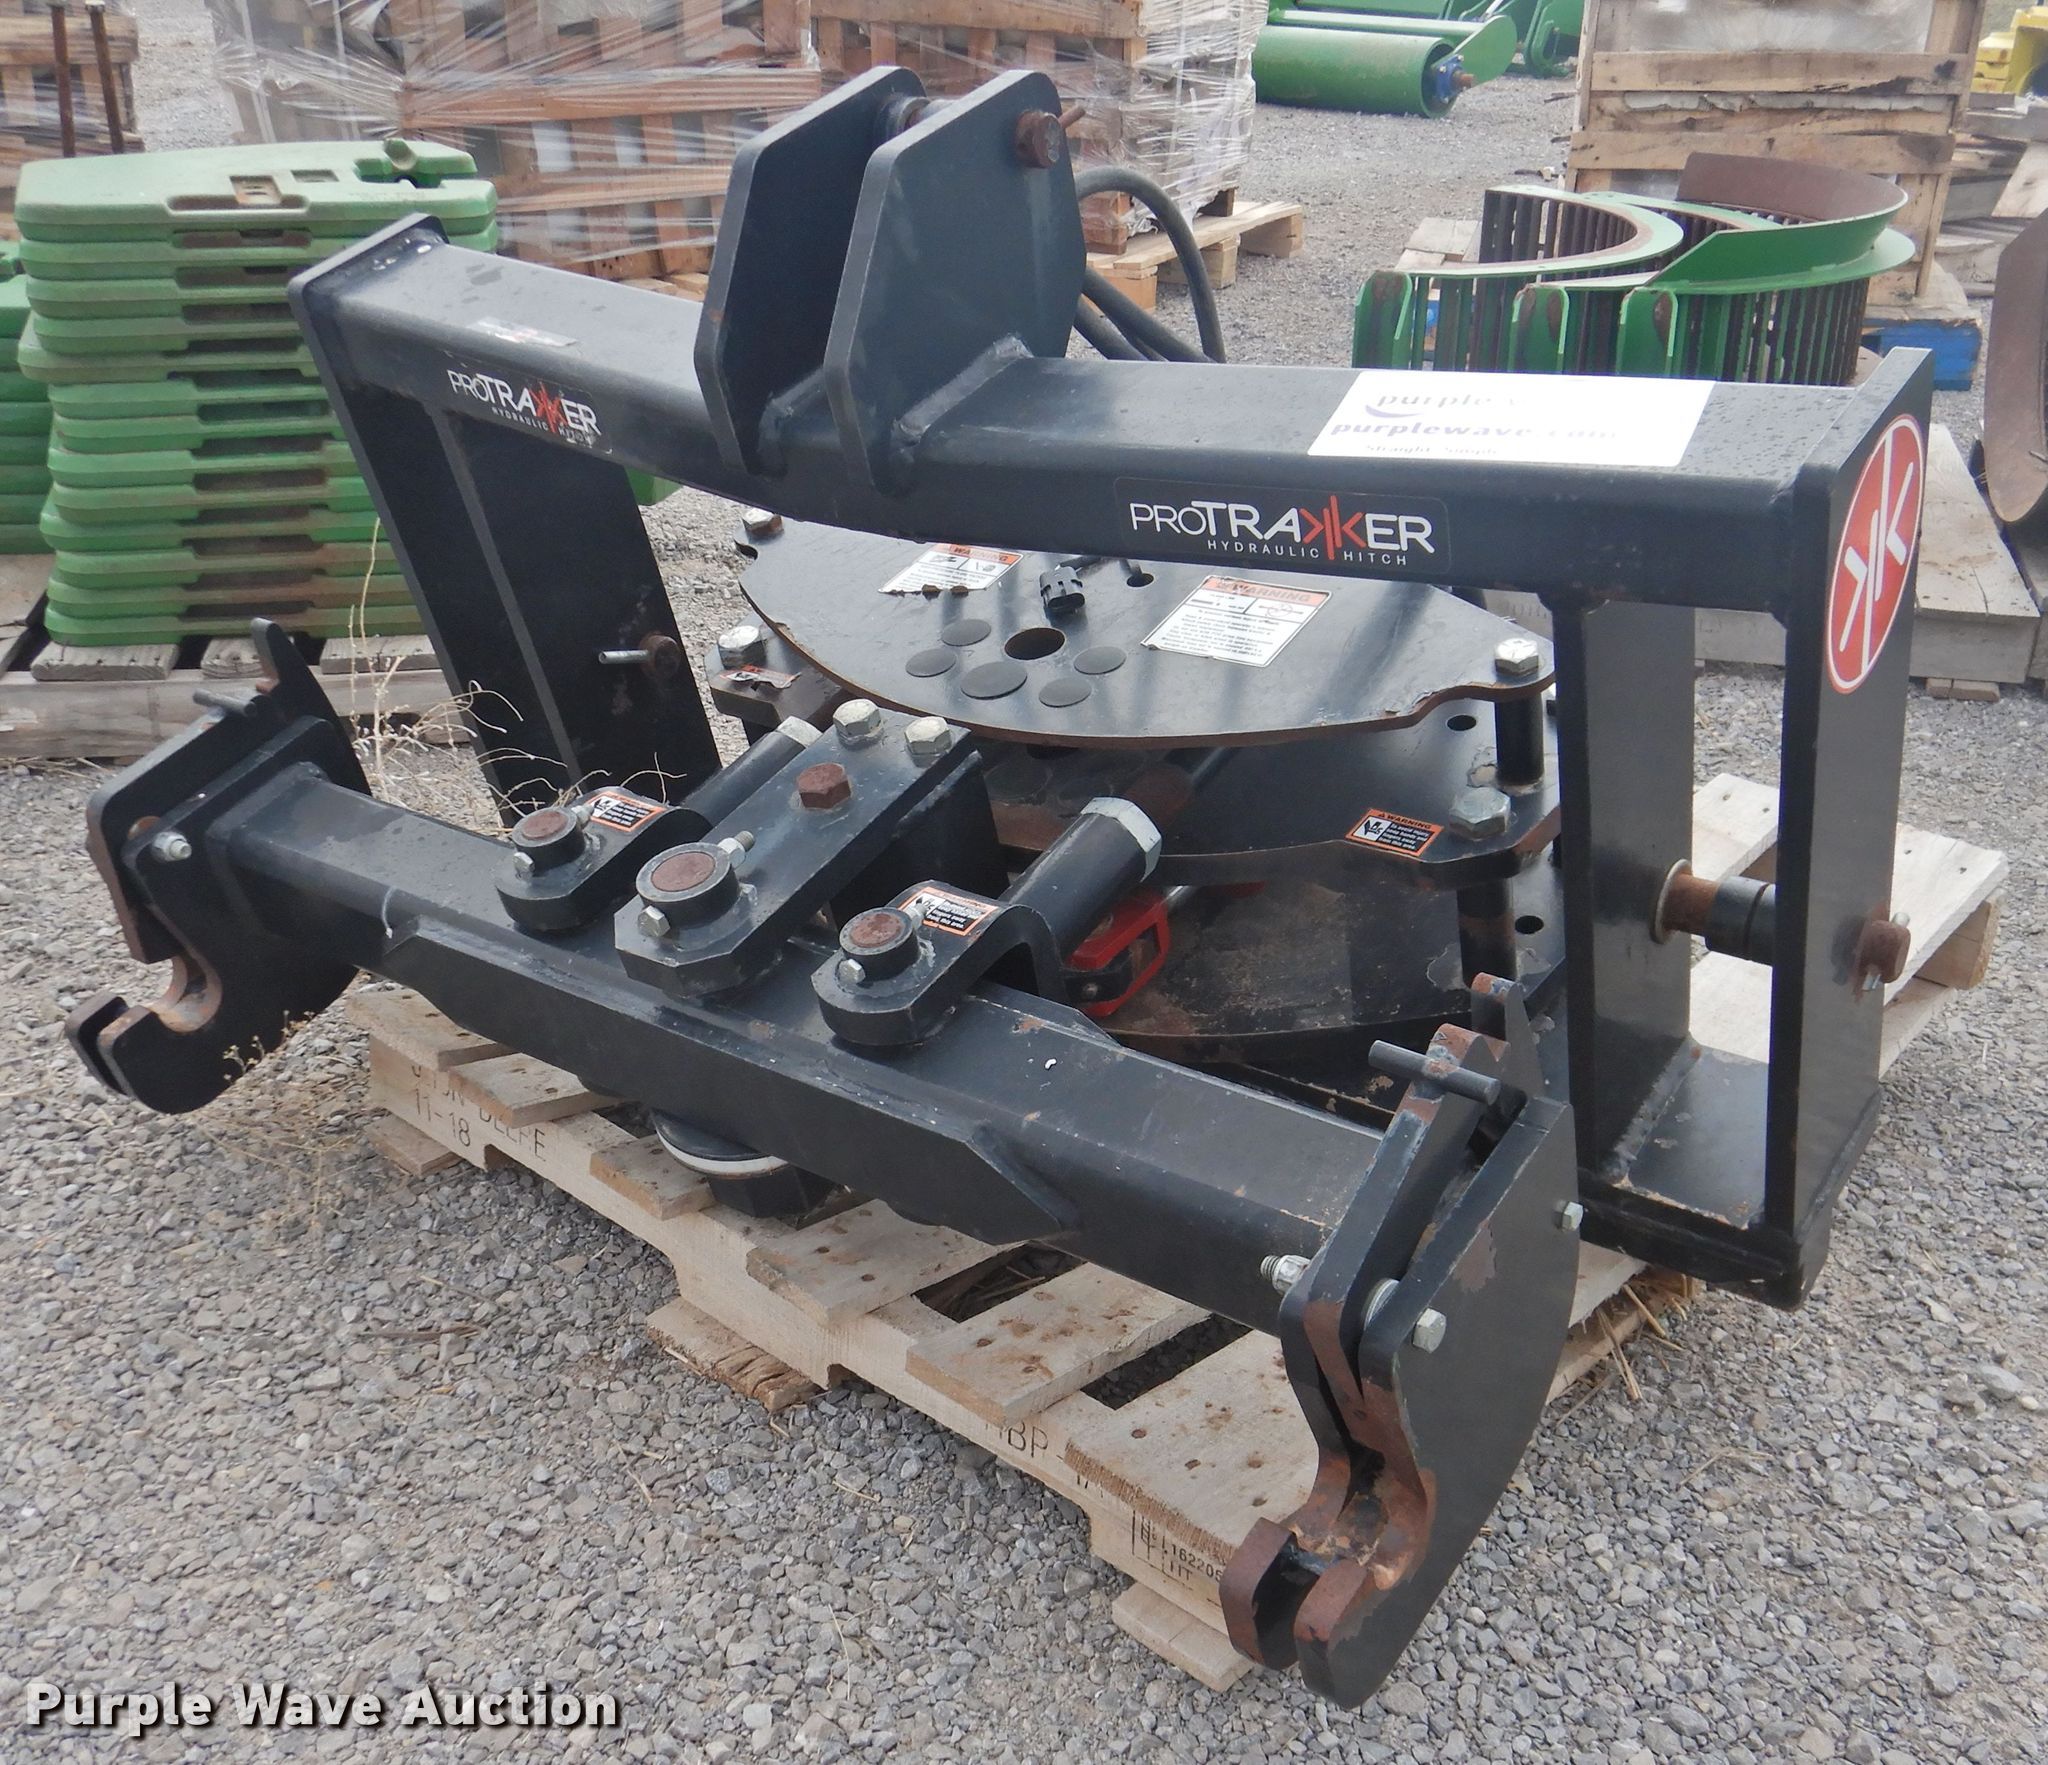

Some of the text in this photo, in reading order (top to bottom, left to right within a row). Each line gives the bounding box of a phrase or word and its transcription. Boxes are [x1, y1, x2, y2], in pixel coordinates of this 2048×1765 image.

[1129, 495, 1435, 561] PROTRAKKER
[1207, 539, 1408, 566] HYDRAULIC HITCH
[1232, 582, 1312, 602] WARNING
[1387, 814, 1432, 830] WARNING
